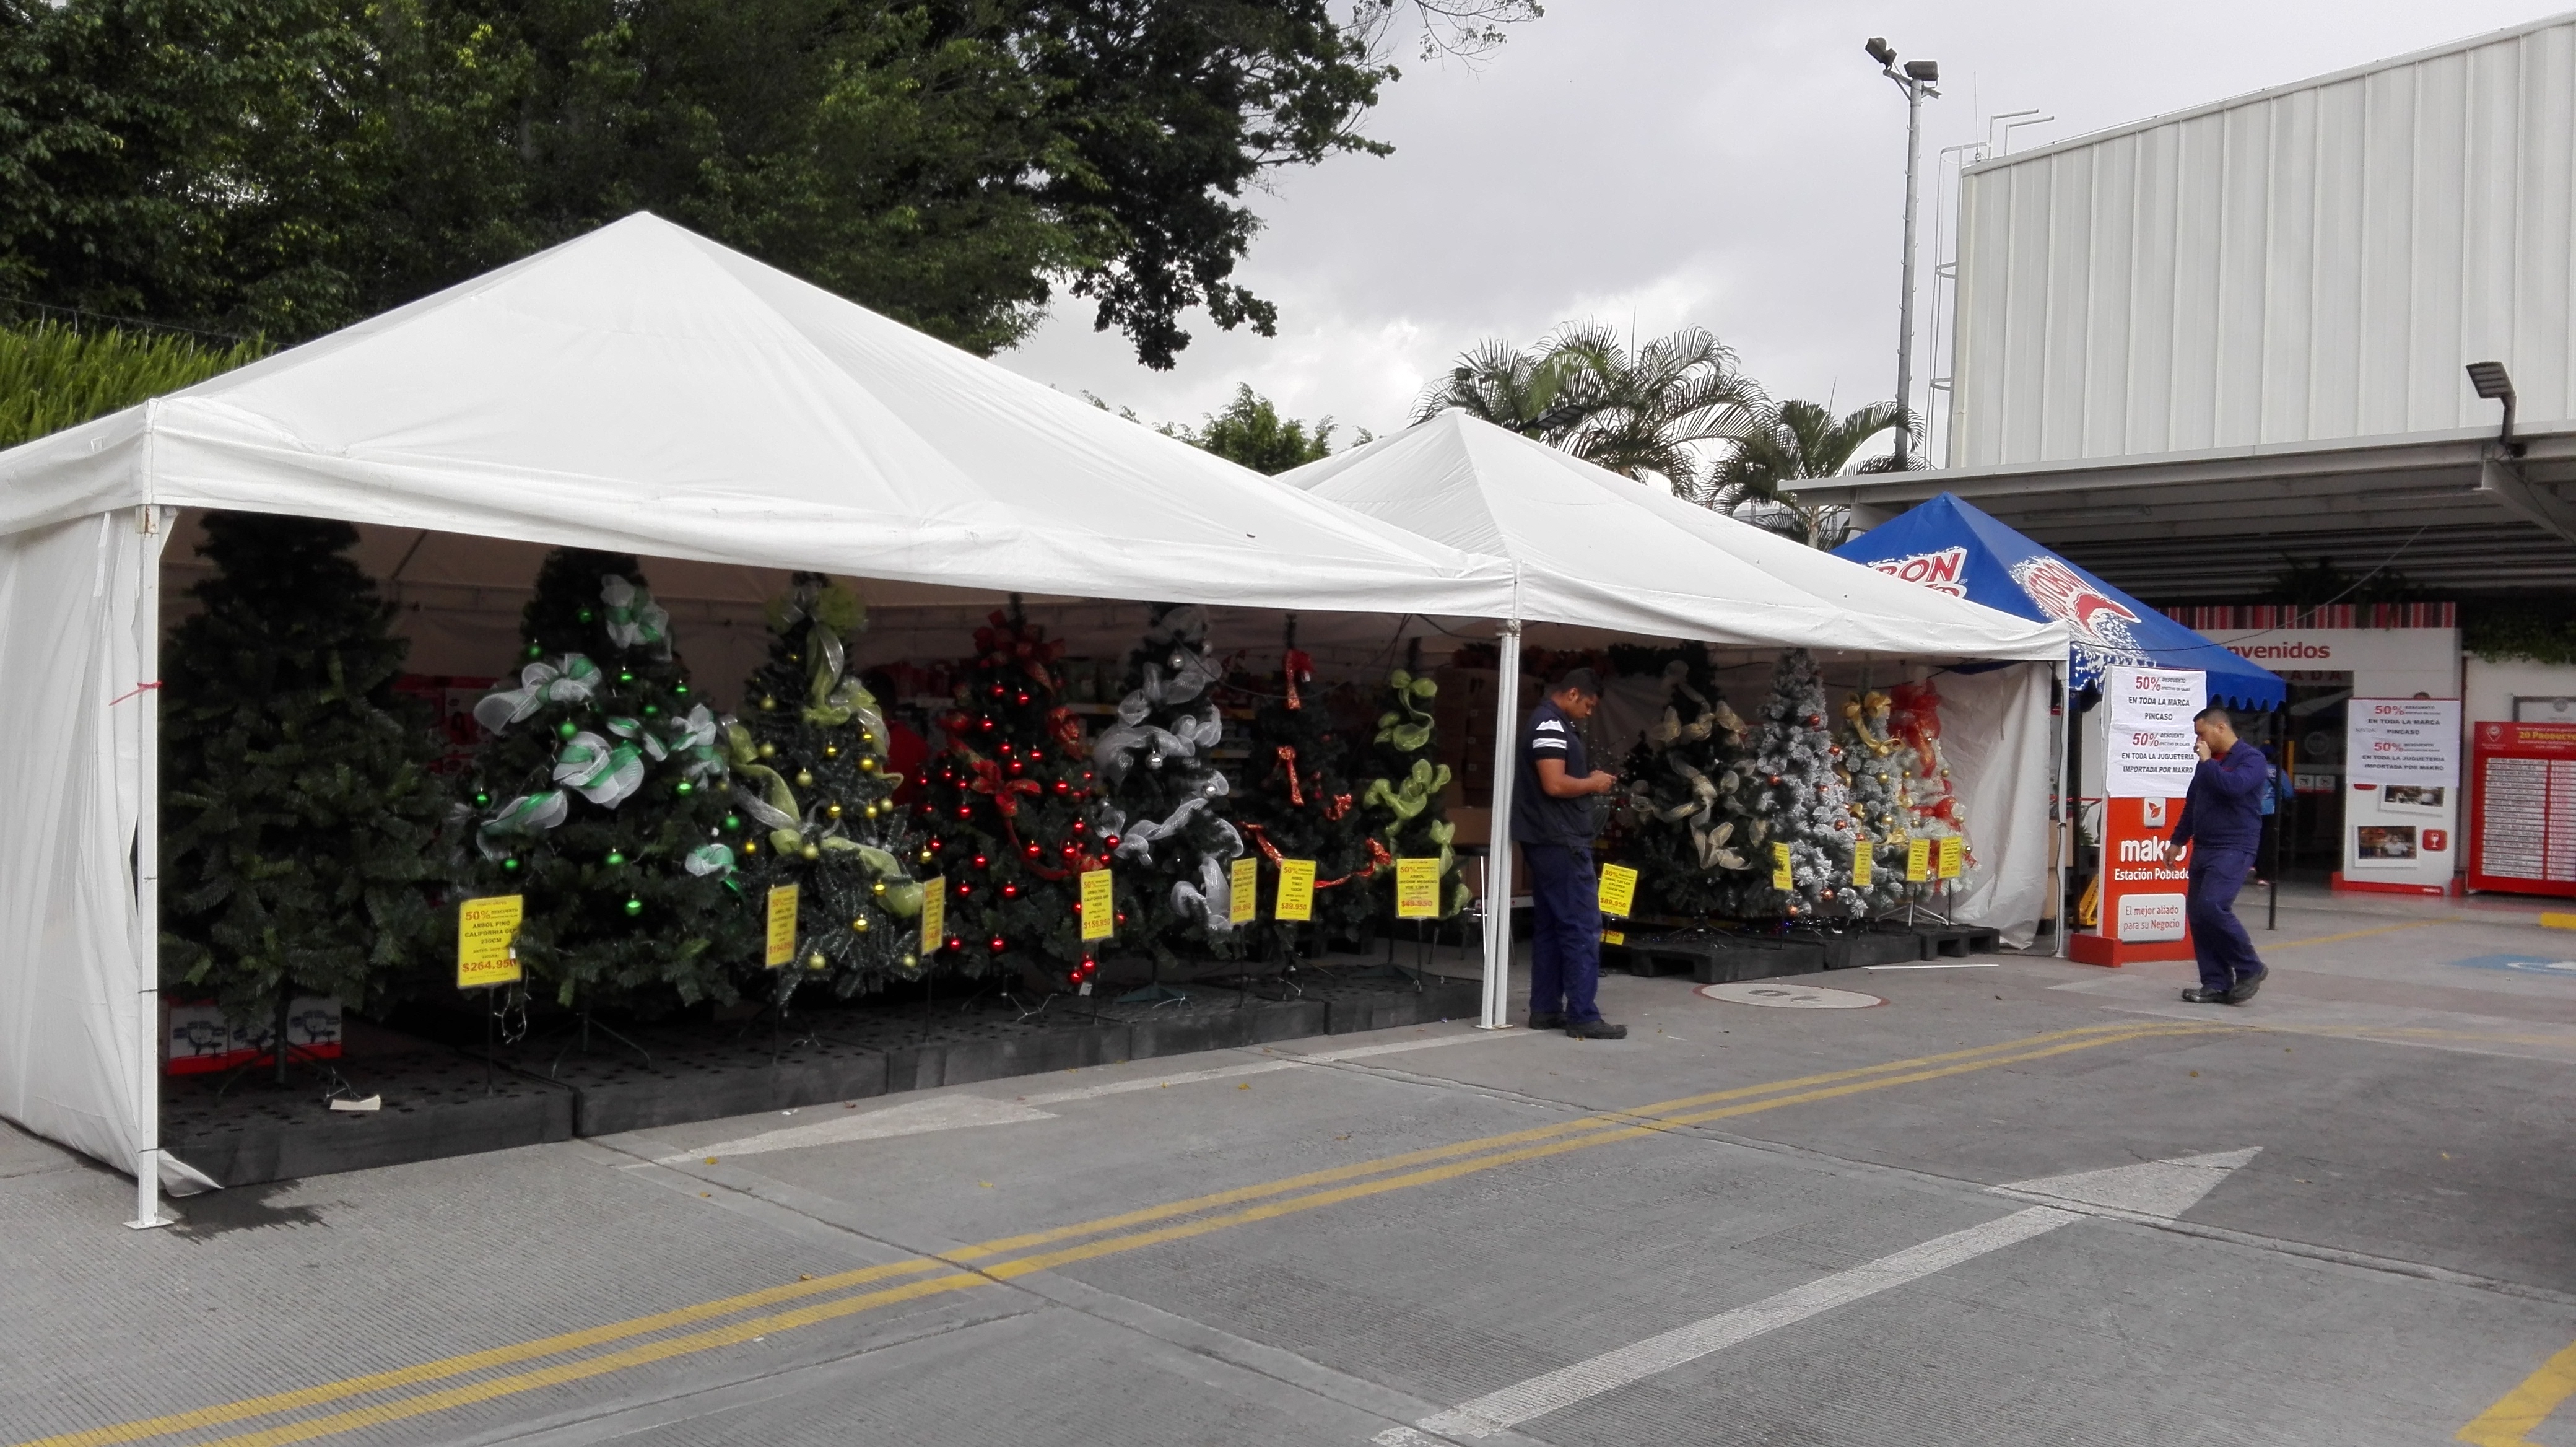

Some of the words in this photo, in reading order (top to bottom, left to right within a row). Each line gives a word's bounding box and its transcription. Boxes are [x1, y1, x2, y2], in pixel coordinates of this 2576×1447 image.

[2227, 642, 2330, 658] nvenidos
[2136, 676, 2160, 691] 50%
[2144, 712, 2173, 720] PINCASO
[2375, 706, 2404, 715] 50%
[2132, 733, 2159, 747] 50%
[2374, 742, 2404, 752] 50%
[1604, 870, 1618, 878] 50%
[2115, 868, 2152, 880] Estación
[1600, 898, 1626, 908] $89.950
[465, 910, 490, 921] 50%
[2125, 906, 2131, 916] El
[2134, 906, 2155, 917] mejor
[2157, 905, 2178, 914] aliado
[2124, 922, 2139, 932] para
[2151, 919, 2180, 931] Negocio
[464, 930, 503, 938] CALIFORNIA
[462, 958, 516, 973] $264.950
